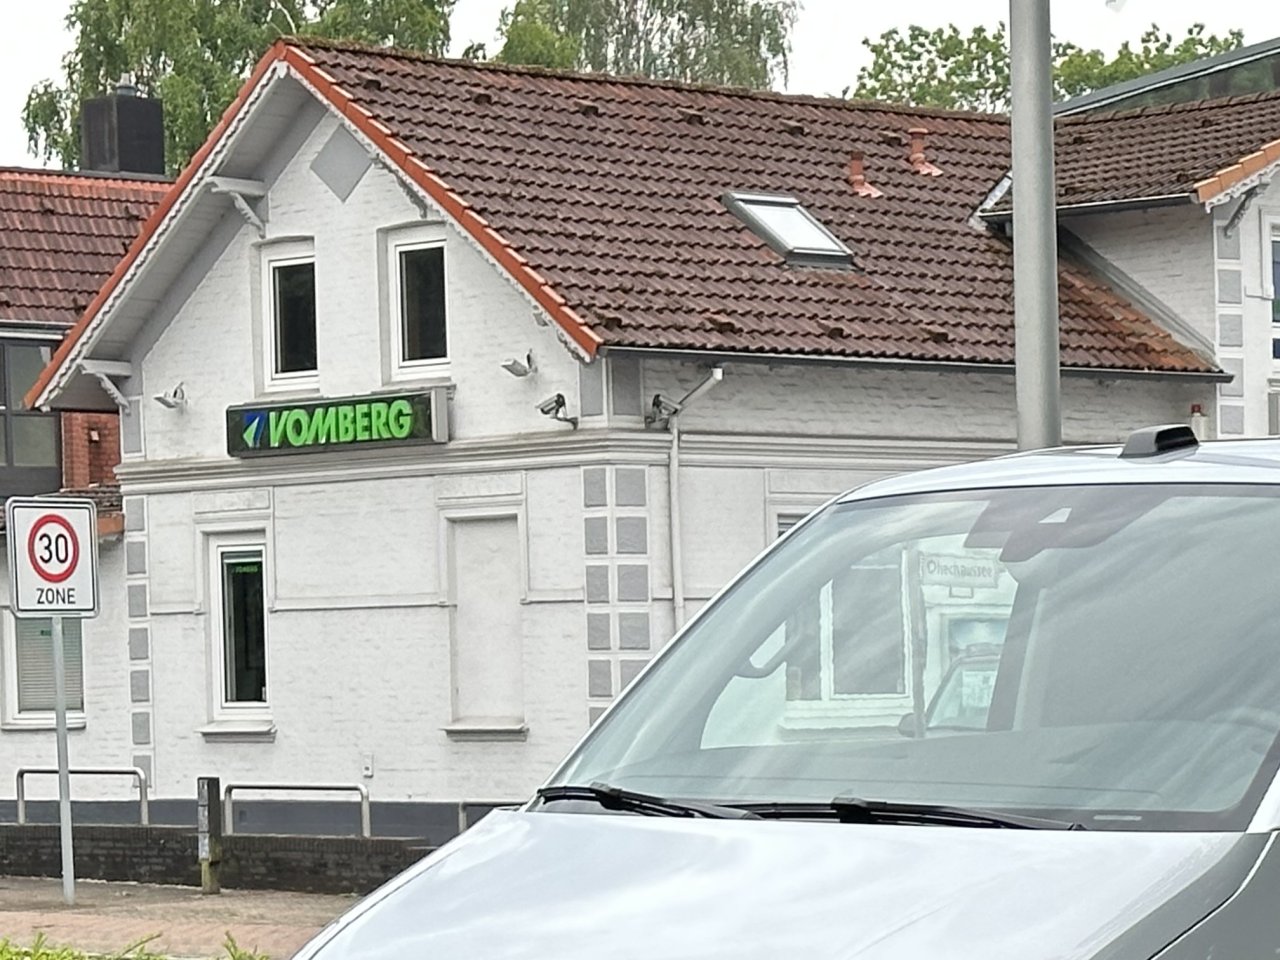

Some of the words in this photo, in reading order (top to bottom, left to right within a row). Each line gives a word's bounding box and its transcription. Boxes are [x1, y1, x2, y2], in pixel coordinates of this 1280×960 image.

[269, 399, 413, 448] VOMBERG
[38, 533, 69, 564] 30
[36, 587, 77, 605] ZONE
